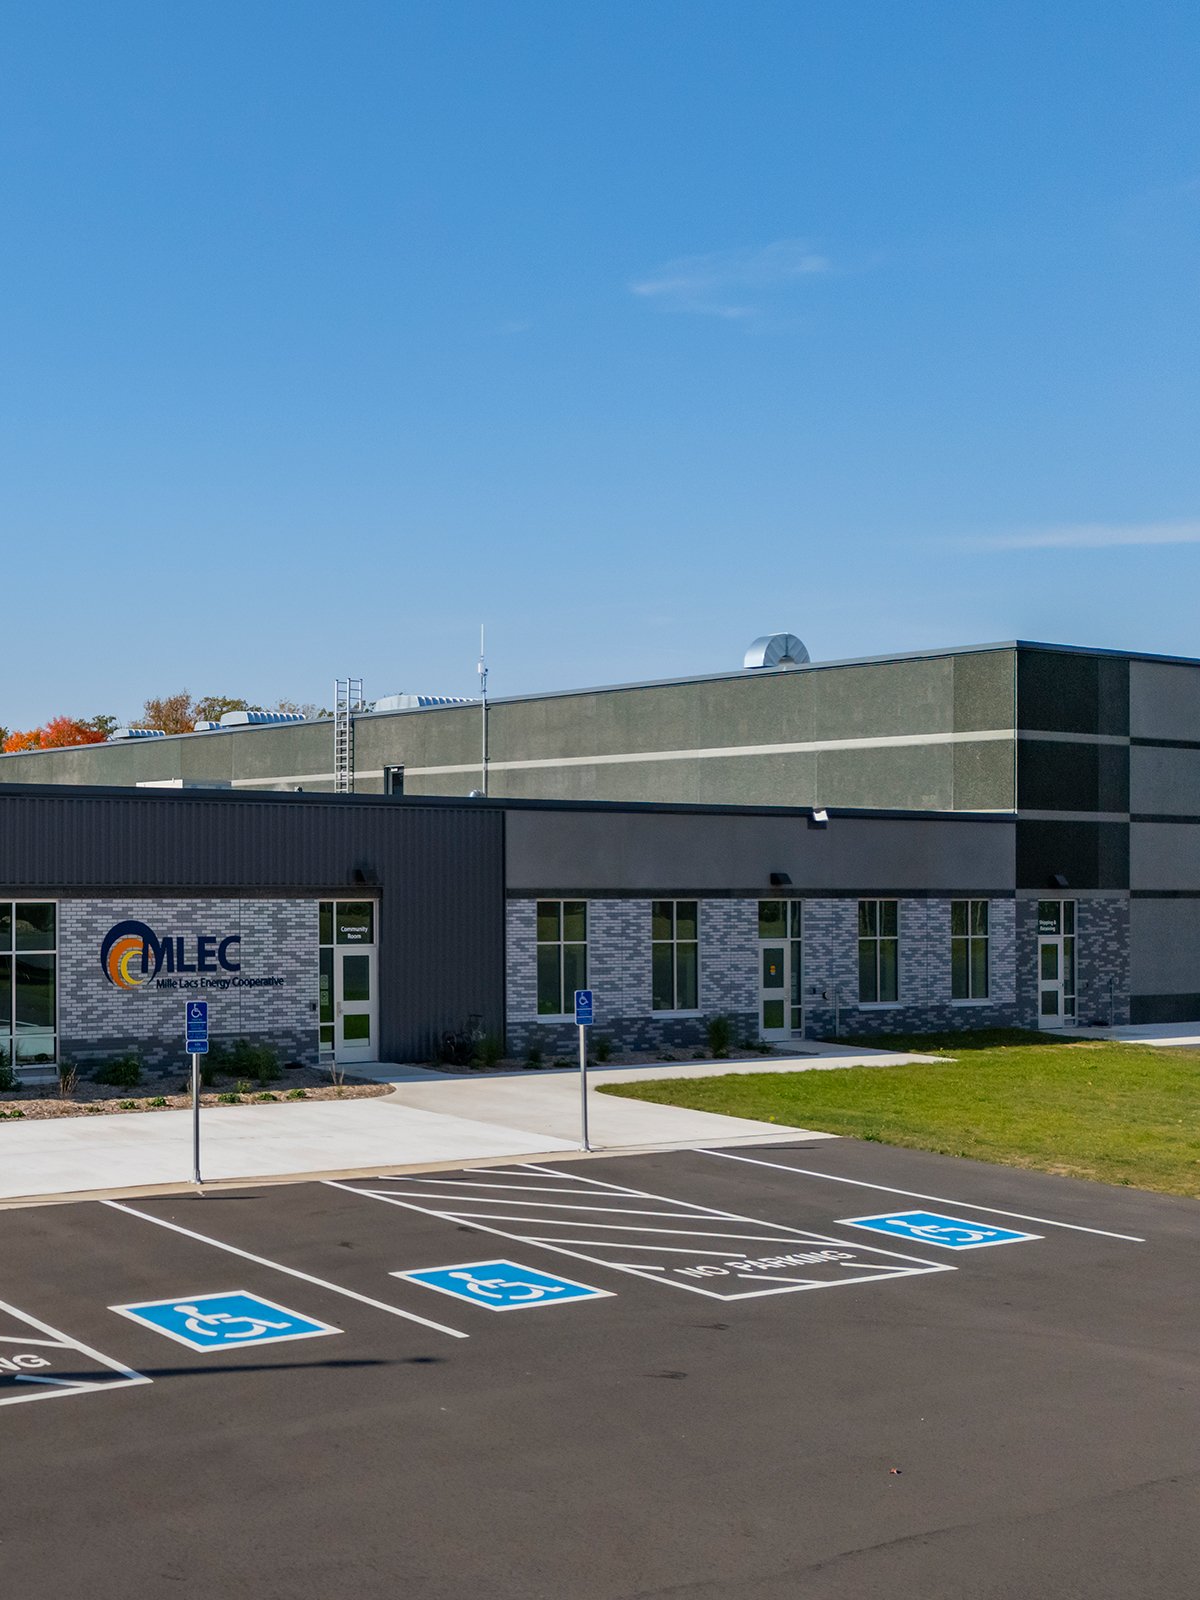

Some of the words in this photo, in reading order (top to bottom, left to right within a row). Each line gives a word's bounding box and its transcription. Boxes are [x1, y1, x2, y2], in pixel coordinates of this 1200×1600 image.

[141, 935, 241, 973] MLEC
[156, 978, 178, 989] Mille
[179, 977, 199, 988] Lacs
[200, 977, 231, 990] Energy
[232, 976, 285, 989] Cooperative
[673, 1265, 730, 1279] NO
[724, 1250, 857, 1272] PARKING
